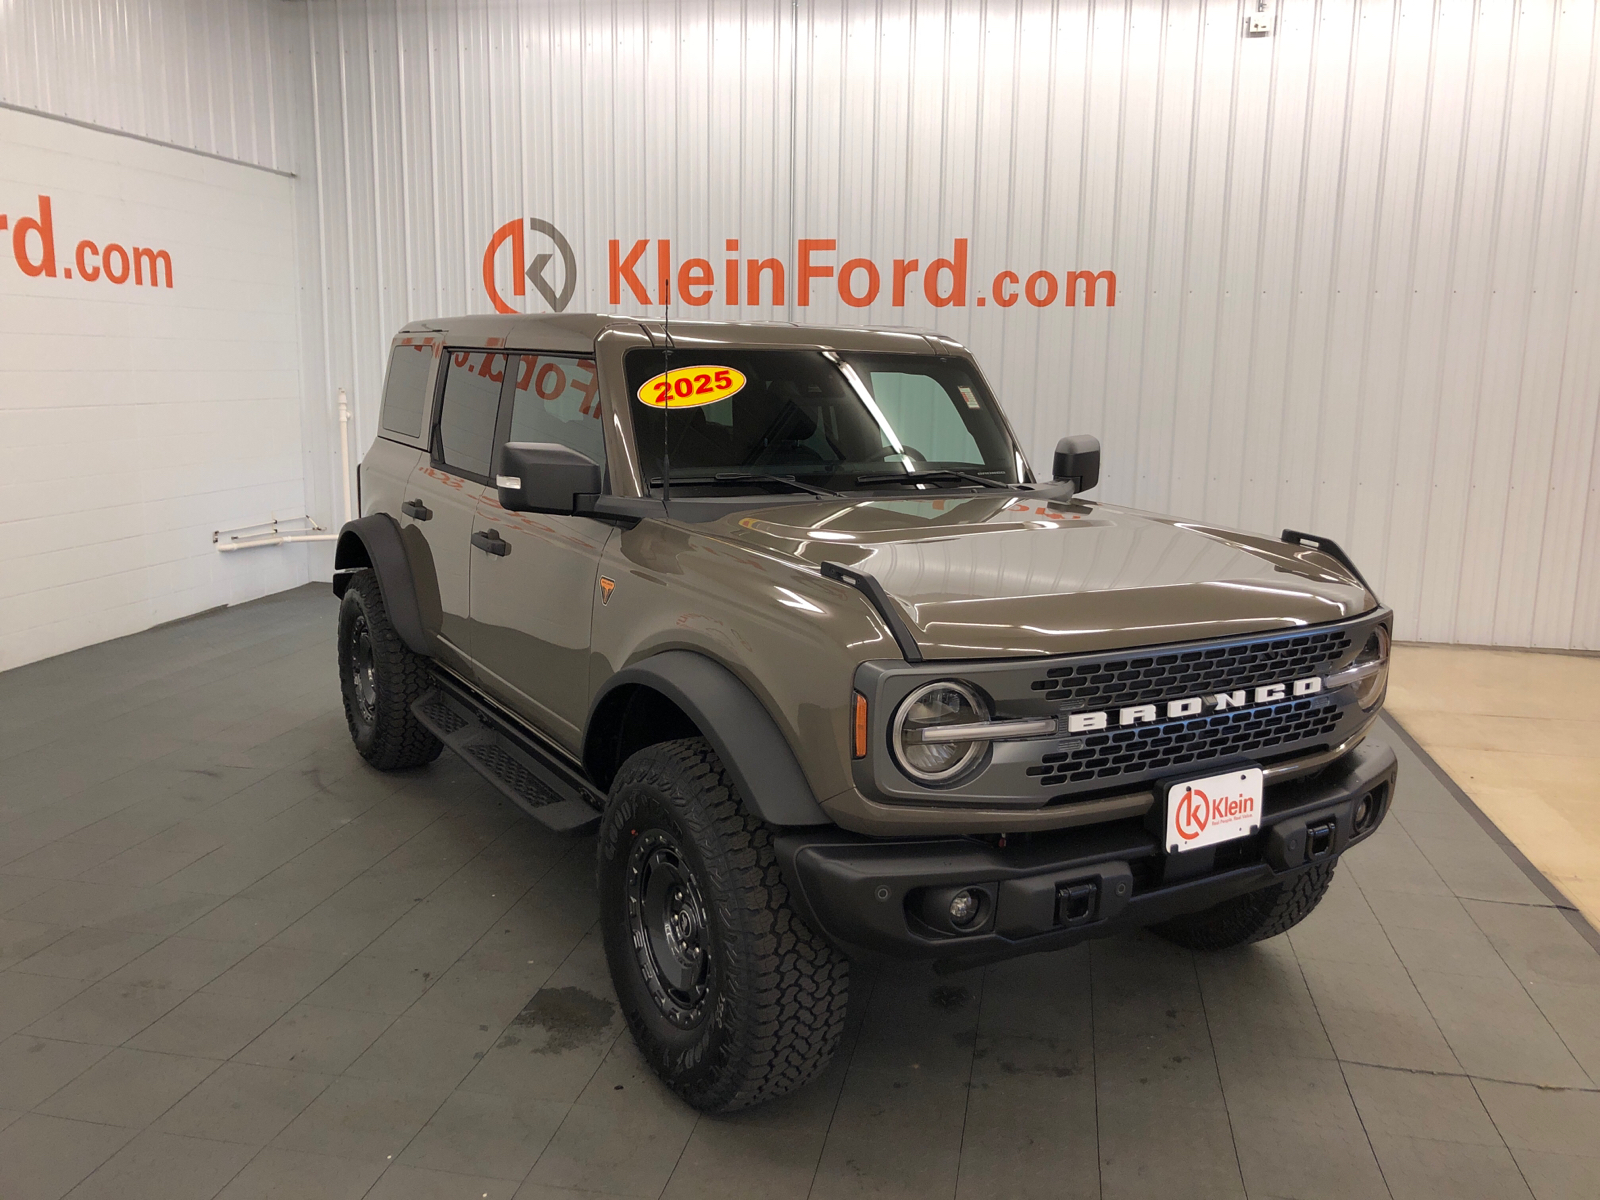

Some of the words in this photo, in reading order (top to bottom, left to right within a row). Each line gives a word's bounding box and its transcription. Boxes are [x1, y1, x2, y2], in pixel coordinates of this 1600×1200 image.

[608, 238, 1117, 307] KleinFord.com
[653, 369, 733, 404] 2025
[1068, 676, 1322, 733] BRONCO
[1212, 793, 1253, 819] Klein
